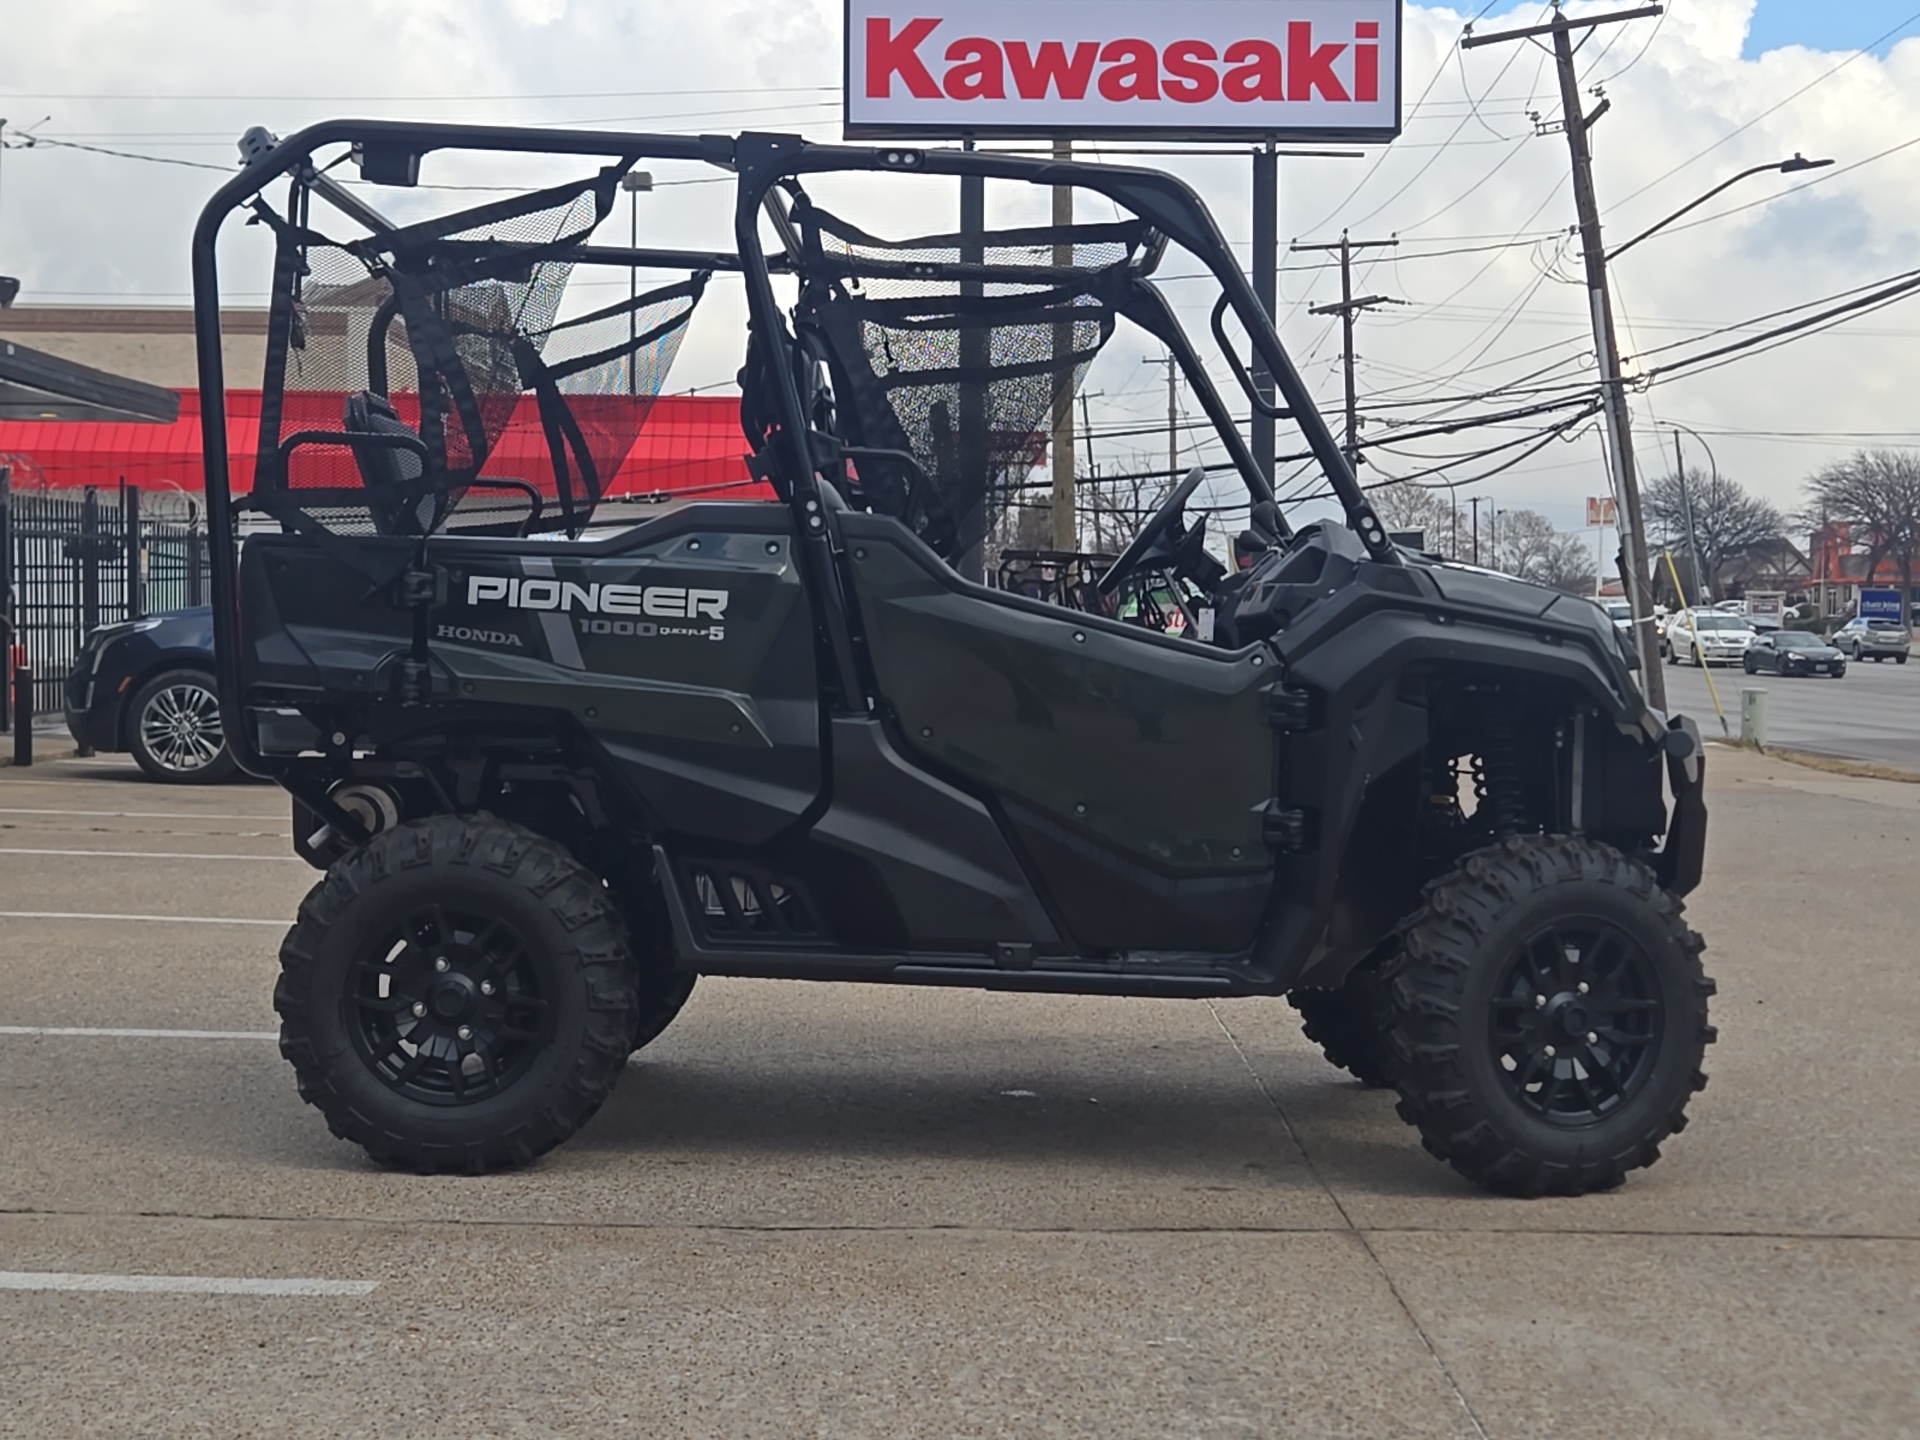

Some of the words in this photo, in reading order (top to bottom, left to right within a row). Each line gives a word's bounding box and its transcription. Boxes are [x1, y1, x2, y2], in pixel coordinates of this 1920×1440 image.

[866, 18, 1379, 103] Kawasaki
[467, 575, 729, 620] PIONEER
[437, 625, 523, 647] HONDA
[579, 618, 658, 637] 1000
